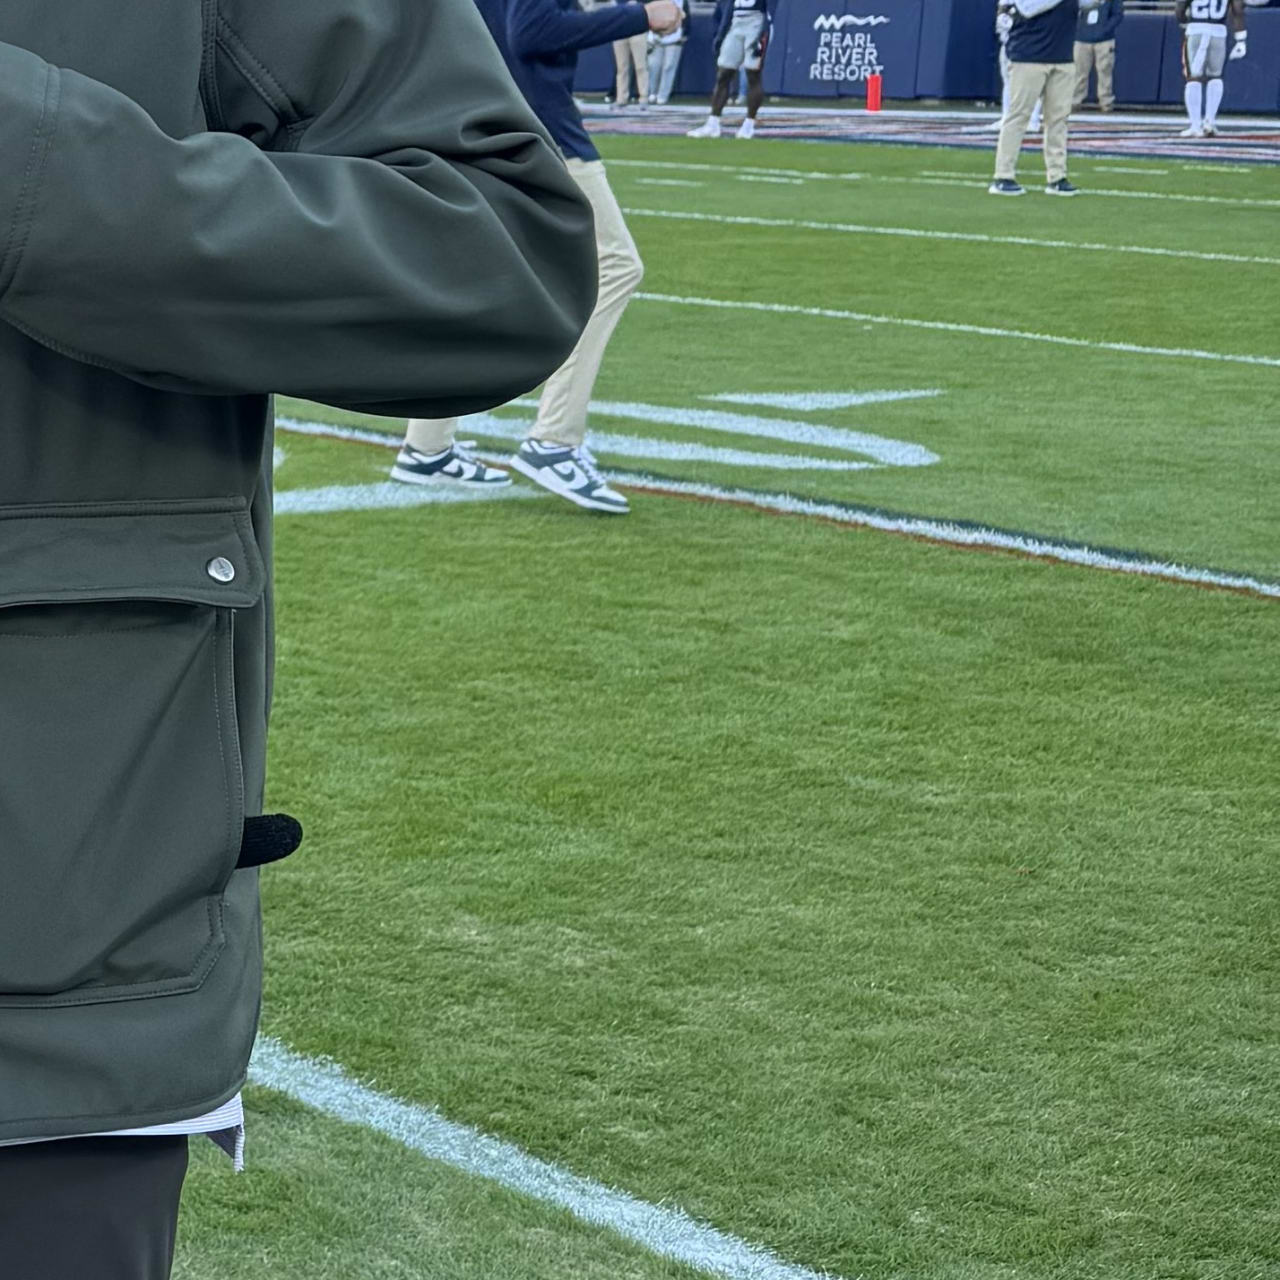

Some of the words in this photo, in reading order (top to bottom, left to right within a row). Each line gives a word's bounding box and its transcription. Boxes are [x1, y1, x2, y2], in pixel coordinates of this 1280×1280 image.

[820, 32, 876, 48] PEARL
[816, 46, 878, 66] RIVER
[809, 63, 884, 82] RESORT
